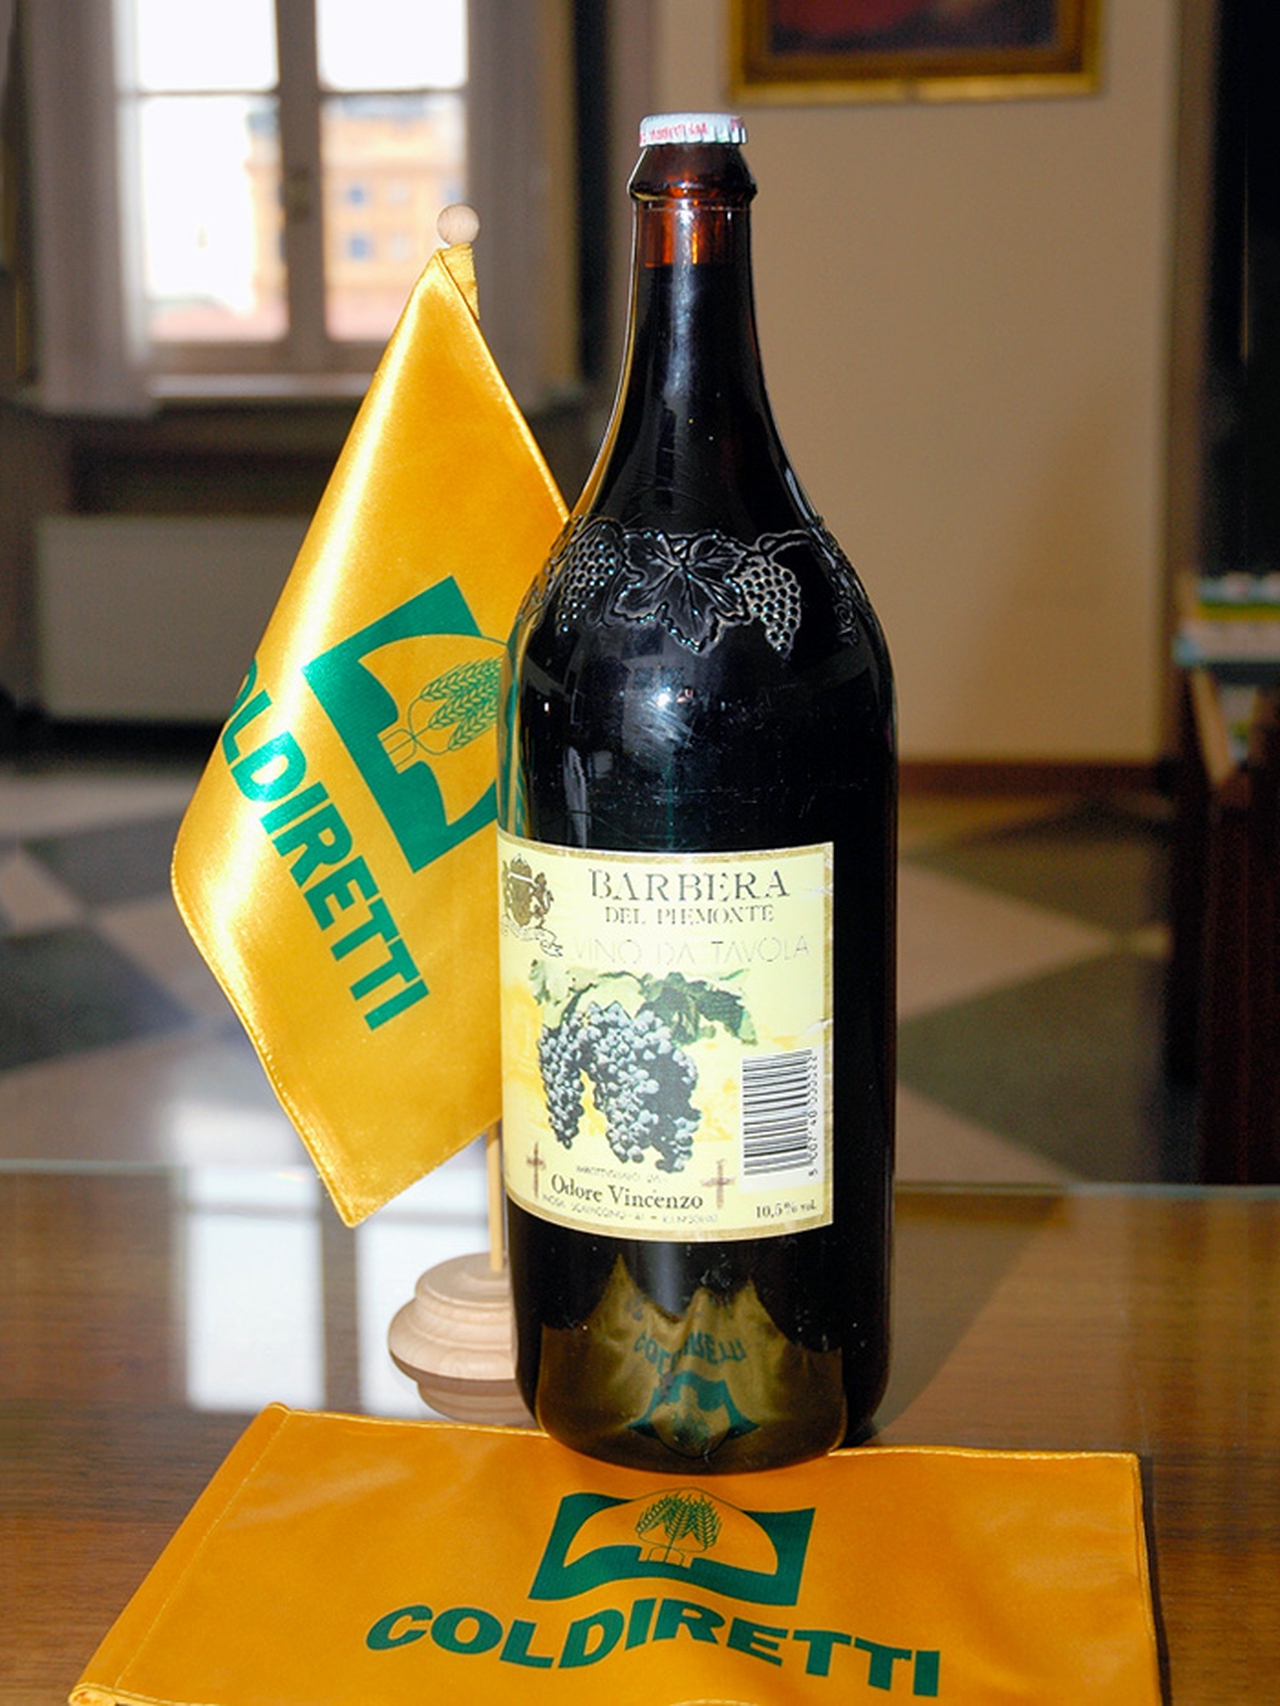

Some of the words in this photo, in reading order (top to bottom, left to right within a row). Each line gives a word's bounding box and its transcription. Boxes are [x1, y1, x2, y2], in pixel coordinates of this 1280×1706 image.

[588, 868, 790, 901] BARBERA
[605, 906, 646, 924] DEL
[657, 904, 775, 925] PIEMONTE
[657, 941, 696, 966] DA
[711, 935, 810, 965] TAVOLA
[551, 1173, 603, 1203] Odore
[607, 1184, 704, 1210] Vincenzo
[366, 1599, 940, 1697] COLDIRETTI
